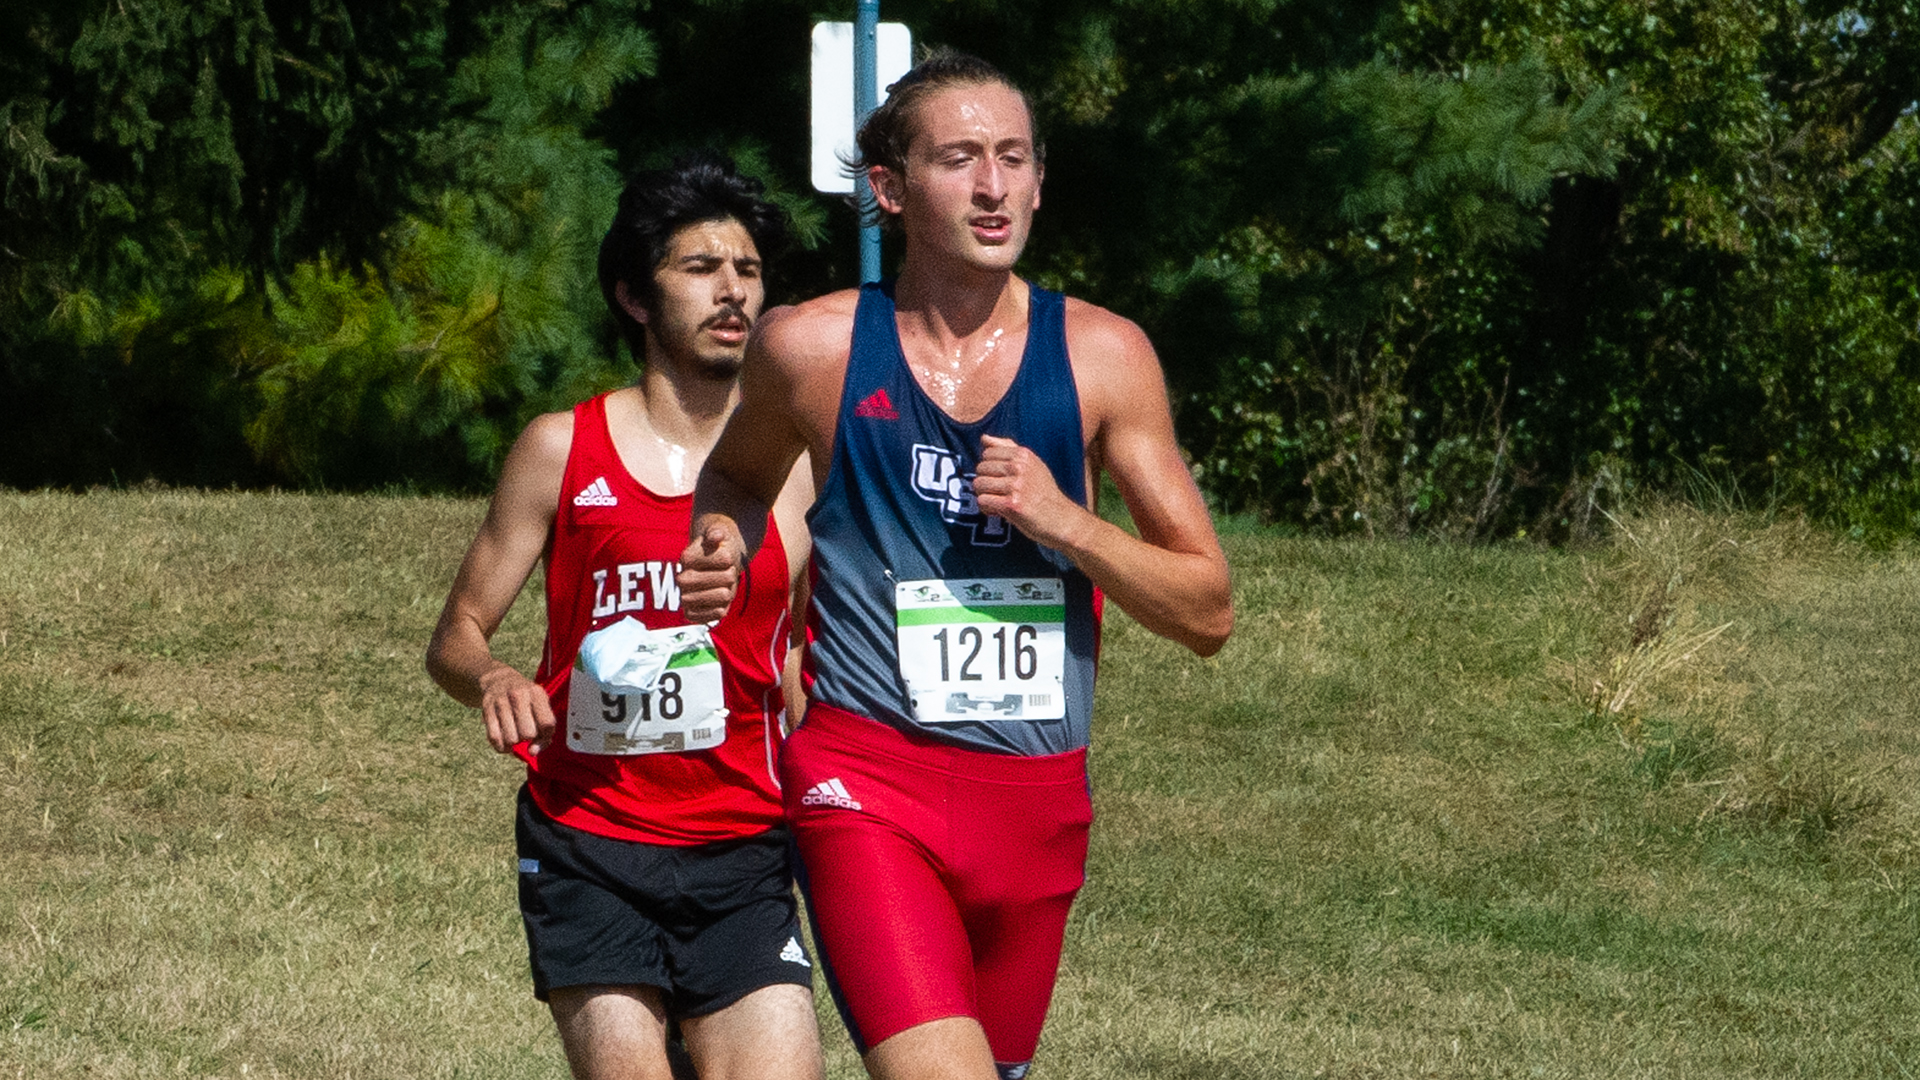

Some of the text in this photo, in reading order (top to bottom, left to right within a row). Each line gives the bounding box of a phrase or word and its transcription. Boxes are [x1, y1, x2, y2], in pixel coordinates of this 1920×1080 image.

[573, 495, 618, 506] adidas
[933, 625, 1037, 681] 1216
[602, 672, 683, 723] 918
[801, 793, 862, 811] adidas
